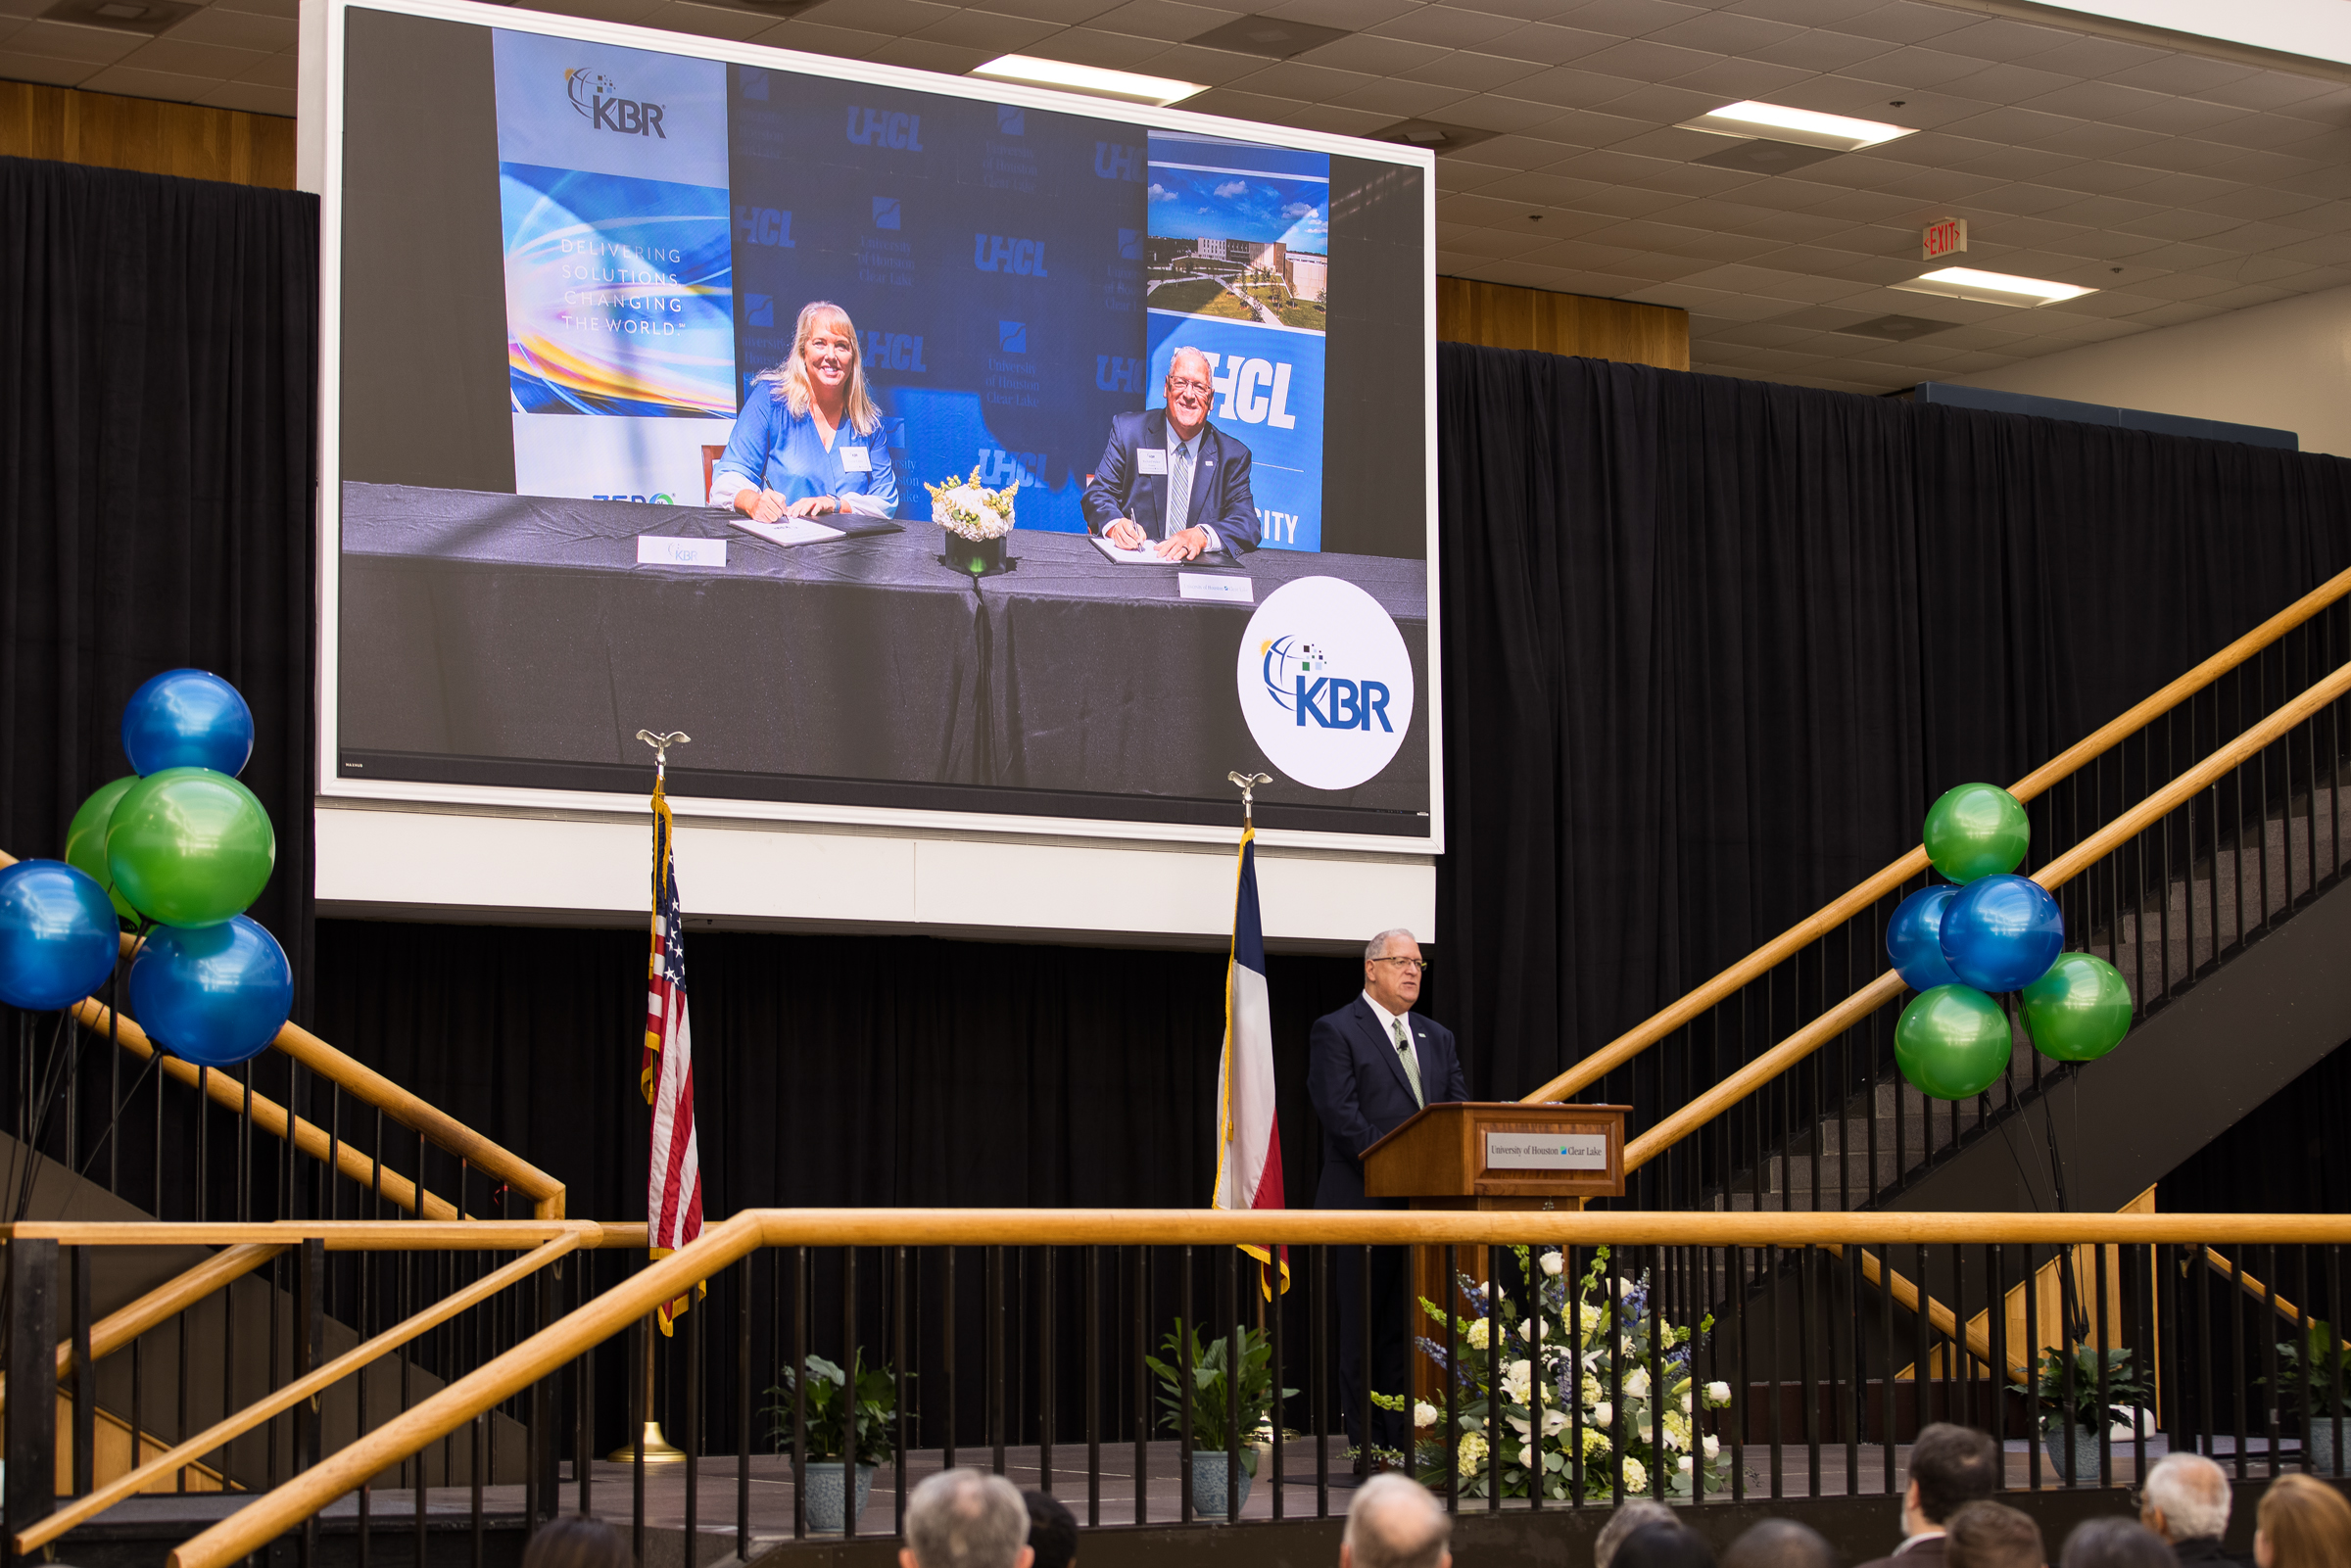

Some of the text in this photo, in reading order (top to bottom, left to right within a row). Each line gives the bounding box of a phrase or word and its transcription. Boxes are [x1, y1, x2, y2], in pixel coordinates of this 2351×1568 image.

[846, 106, 923, 152] UHCL
[735, 206, 795, 248] HCL
[861, 235, 912, 257] University
[1930, 221, 1956, 256] EXIT
[561, 238, 681, 263] DELIVERING
[975, 233, 1048, 278] UHCL
[564, 291, 682, 312] CHANGING
[561, 315, 600, 331] THE
[988, 358, 1036, 378] University
[985, 374, 1039, 391] of Houston
[986, 391, 1039, 407] Clear Lake
[979, 449, 1050, 489] UHCL
[675, 549, 698, 561] KBR
[1296, 675, 1394, 733] KBR
[1491, 1145, 1603, 1157] University of Houston Clear Lake
